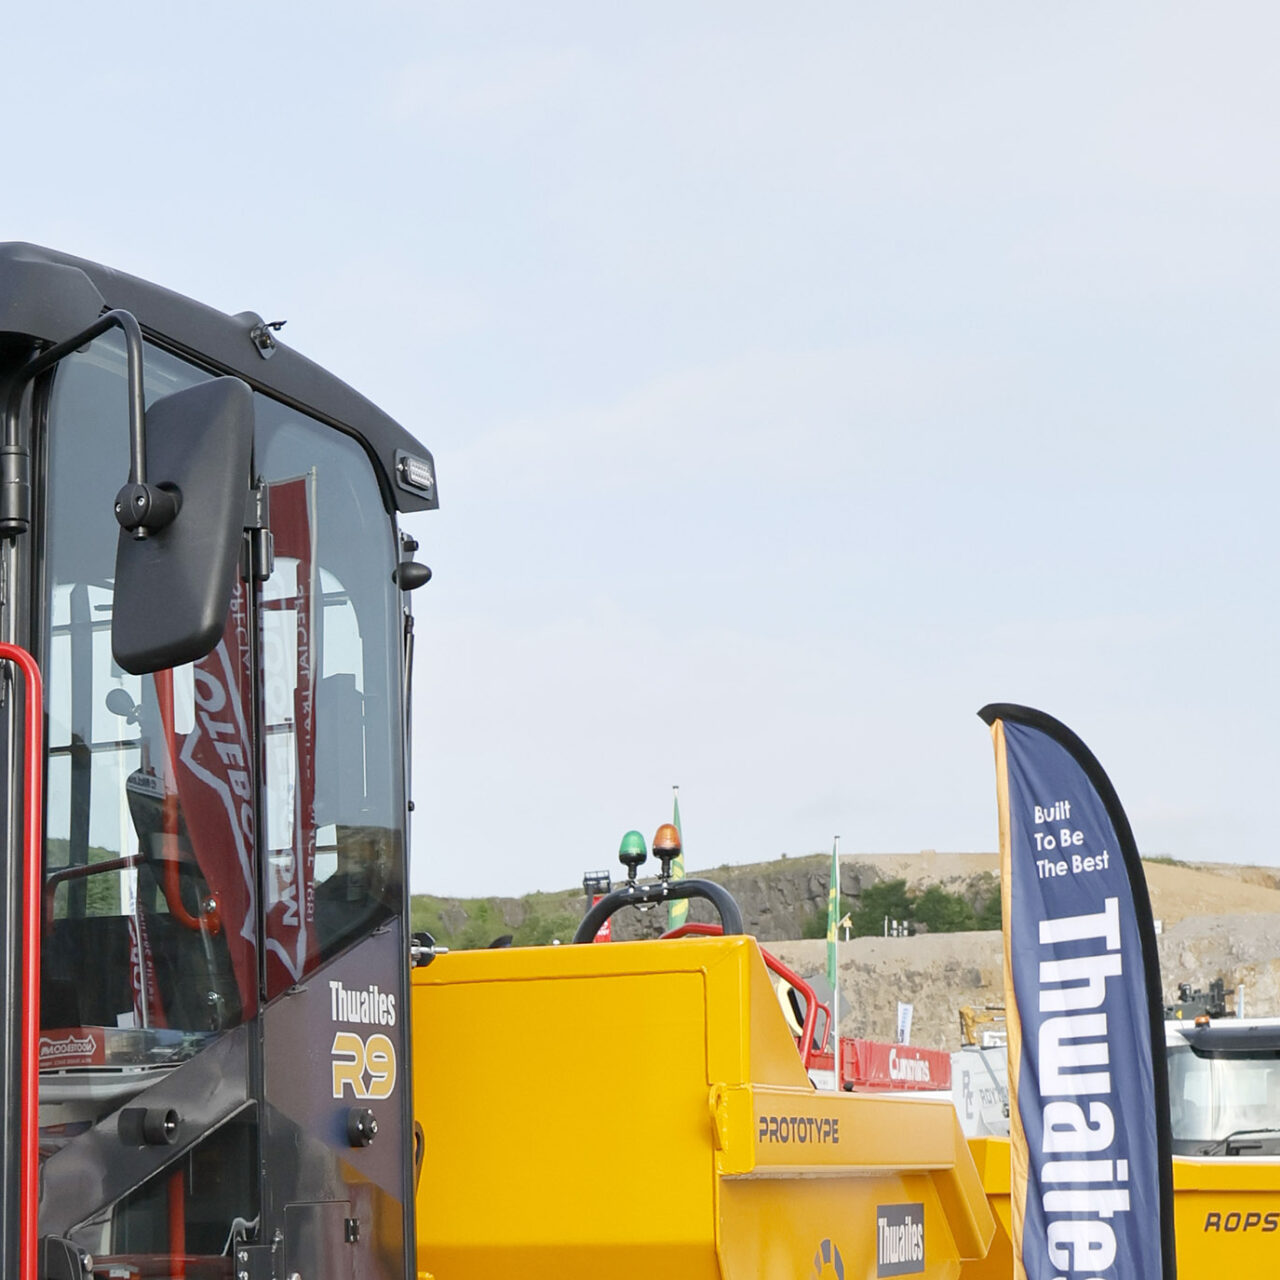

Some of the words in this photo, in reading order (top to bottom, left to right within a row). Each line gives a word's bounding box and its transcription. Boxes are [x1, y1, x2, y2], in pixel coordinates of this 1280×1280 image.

[1034, 800, 1071, 824] Built
[1034, 833, 1056, 851] To
[1060, 829, 1084, 848] Be
[1037, 859, 1068, 878] The
[1072, 850, 1109, 873] Best
[329, 980, 396, 1026] Thwaites
[331, 1031, 396, 1099] R9
[889, 1048, 931, 1083] Cummins
[759, 1116, 839, 1144] PROTOTYPE
[1204, 1212, 1280, 1232] ROPS
[878, 1216, 923, 1265] Thwaites
